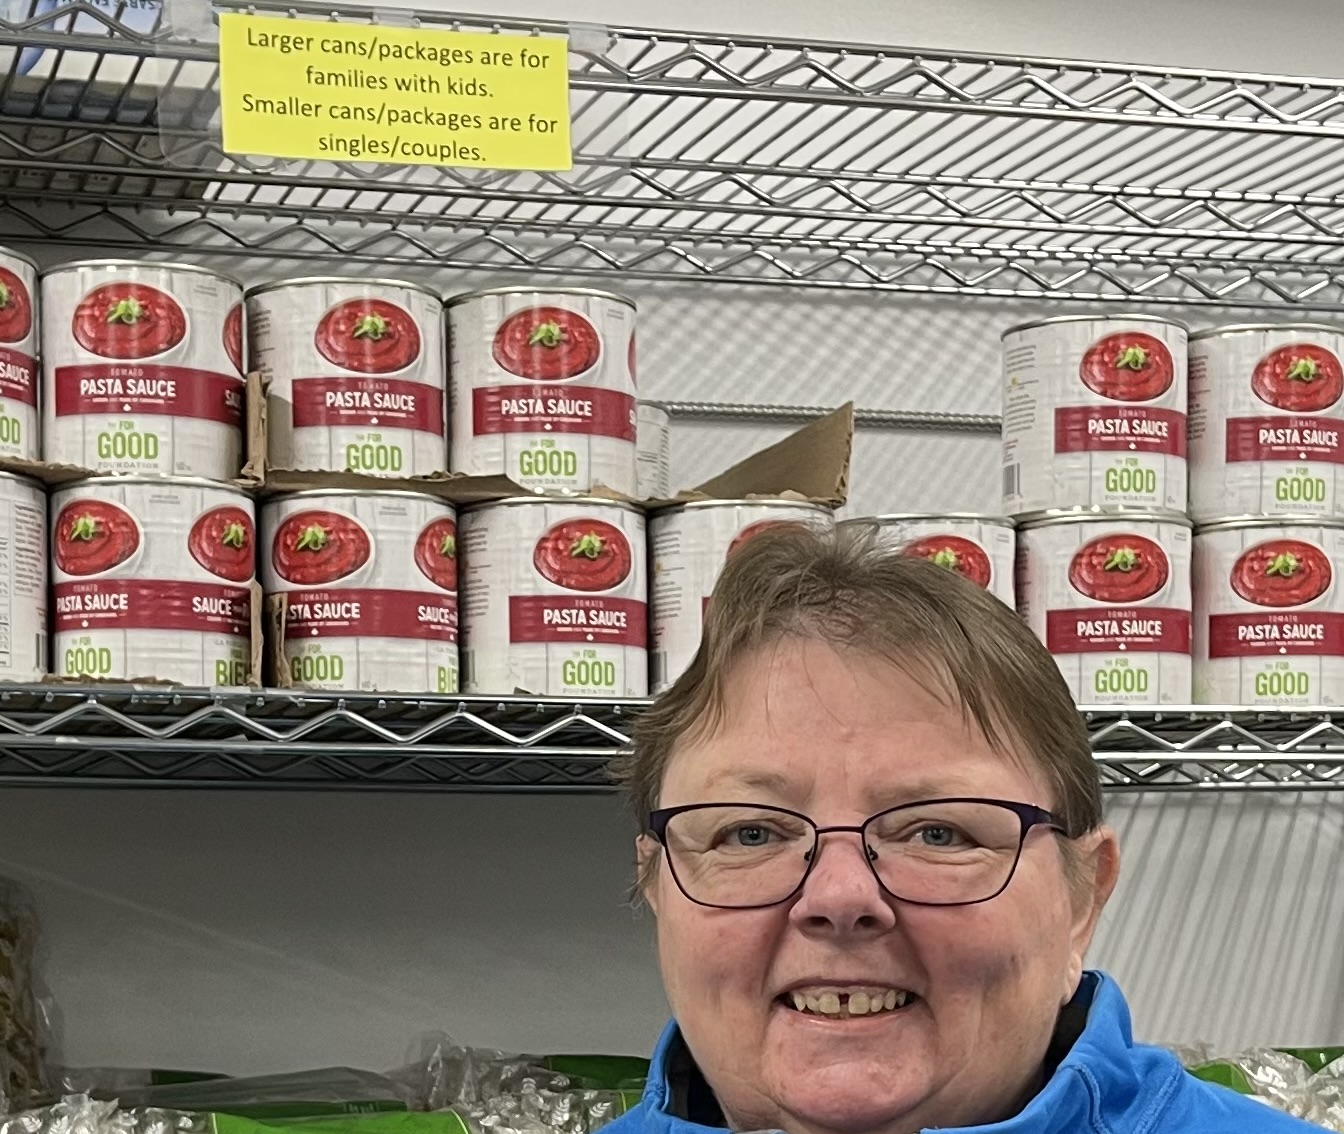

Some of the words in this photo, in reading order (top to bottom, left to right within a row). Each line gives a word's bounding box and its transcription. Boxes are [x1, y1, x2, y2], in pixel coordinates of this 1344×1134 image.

[247, 27, 314, 53] Larger
[320, 36, 474, 66] cans/packages
[480, 52, 513, 67] are
[519, 48, 550, 68] for
[305, 66, 387, 90] families
[394, 74, 440, 95] with
[447, 77, 494, 98] kids.
[242, 94, 322, 117] Smaller
[328, 103, 482, 132] cans/packages
[488, 116, 522, 132] are
[528, 113, 558, 134] for
[318, 134, 487, 162] singles/couples.
[80, 378, 123, 396] PASTA
[126, 378, 177, 398] SAUCE
[325, 391, 369, 409] PASTA
[373, 393, 416, 412] SAUCE
[500, 399, 545, 416] PASTA
[547, 399, 593, 417] SAUCE
[1087, 418, 1129, 436] PASTA
[1131, 418, 1169, 438] SAUCE
[1258, 427, 1300, 446] PASTA
[1302, 429, 1339, 448] SAUCE
[97, 431, 158, 460] GOOD
[345, 443, 403, 473] GOOD
[519, 449, 577, 477] GOOD
[1104, 466, 1156, 494] GOOD
[1275, 476, 1326, 502] GOOD
[85, 594, 128, 611] SAUCE
[192, 597, 232, 615] SAUCE
[314, 602, 361, 618] SAUCE
[418, 606, 449, 624] SAUCE
[543, 609, 585, 625] PASTA
[588, 611, 627, 627] SAUCE
[1077, 621, 1119, 636] PASTA
[1122, 620, 1162, 636] SAUCE
[1238, 624, 1280, 641] PASTA
[1282, 623, 1324, 640] SAUCE
[65, 648, 112, 674] GOOD
[291, 655, 344, 682] GOOD
[562, 659, 615, 687] GOOD
[1094, 668, 1148, 693] GOOD
[1255, 672, 1309, 698] GOOD
